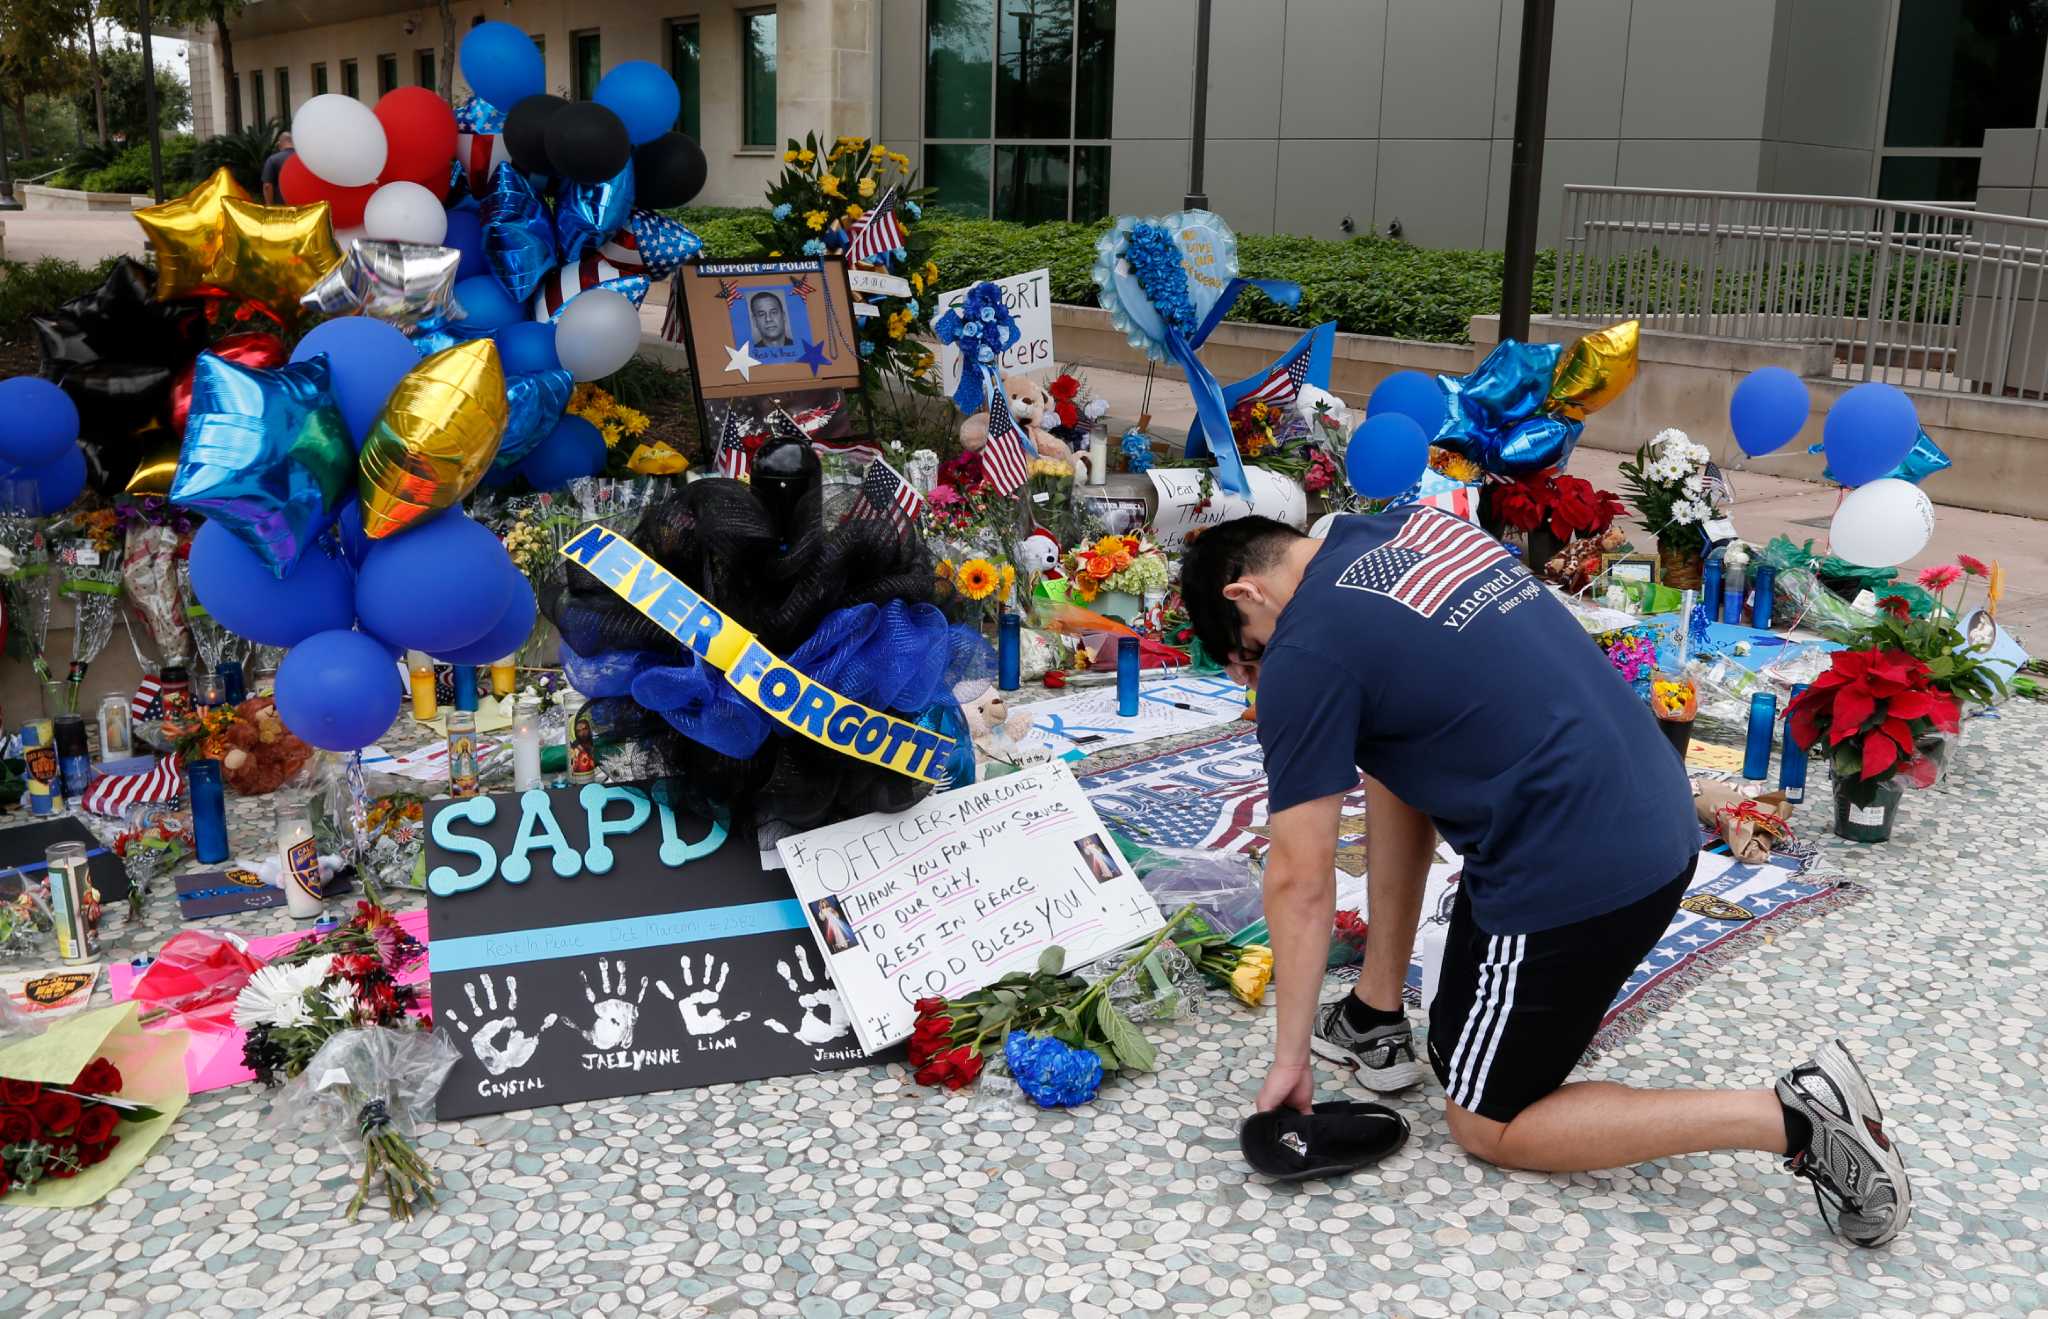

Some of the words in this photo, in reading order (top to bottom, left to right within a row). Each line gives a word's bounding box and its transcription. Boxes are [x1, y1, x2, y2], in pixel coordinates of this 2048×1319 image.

[706, 263, 760, 274] SUPPORT
[779, 260, 819, 271] POLICE
[564, 526, 724, 656] NEVER
[1443, 568, 1514, 630] vineyard
[1498, 596, 1522, 614] since
[1518, 581, 1541, 600] 1998
[731, 641, 957, 780] FORGOTTE
[839, 880, 903, 923] THANK
[852, 922, 886, 953] TO
[894, 897, 929, 924] OUR
[485, 939, 520, 959] Rest
[876, 932, 928, 979] REST
[936, 915, 967, 940] IN
[897, 956, 967, 1006] GOD
[971, 920, 1036, 964] BLESS
